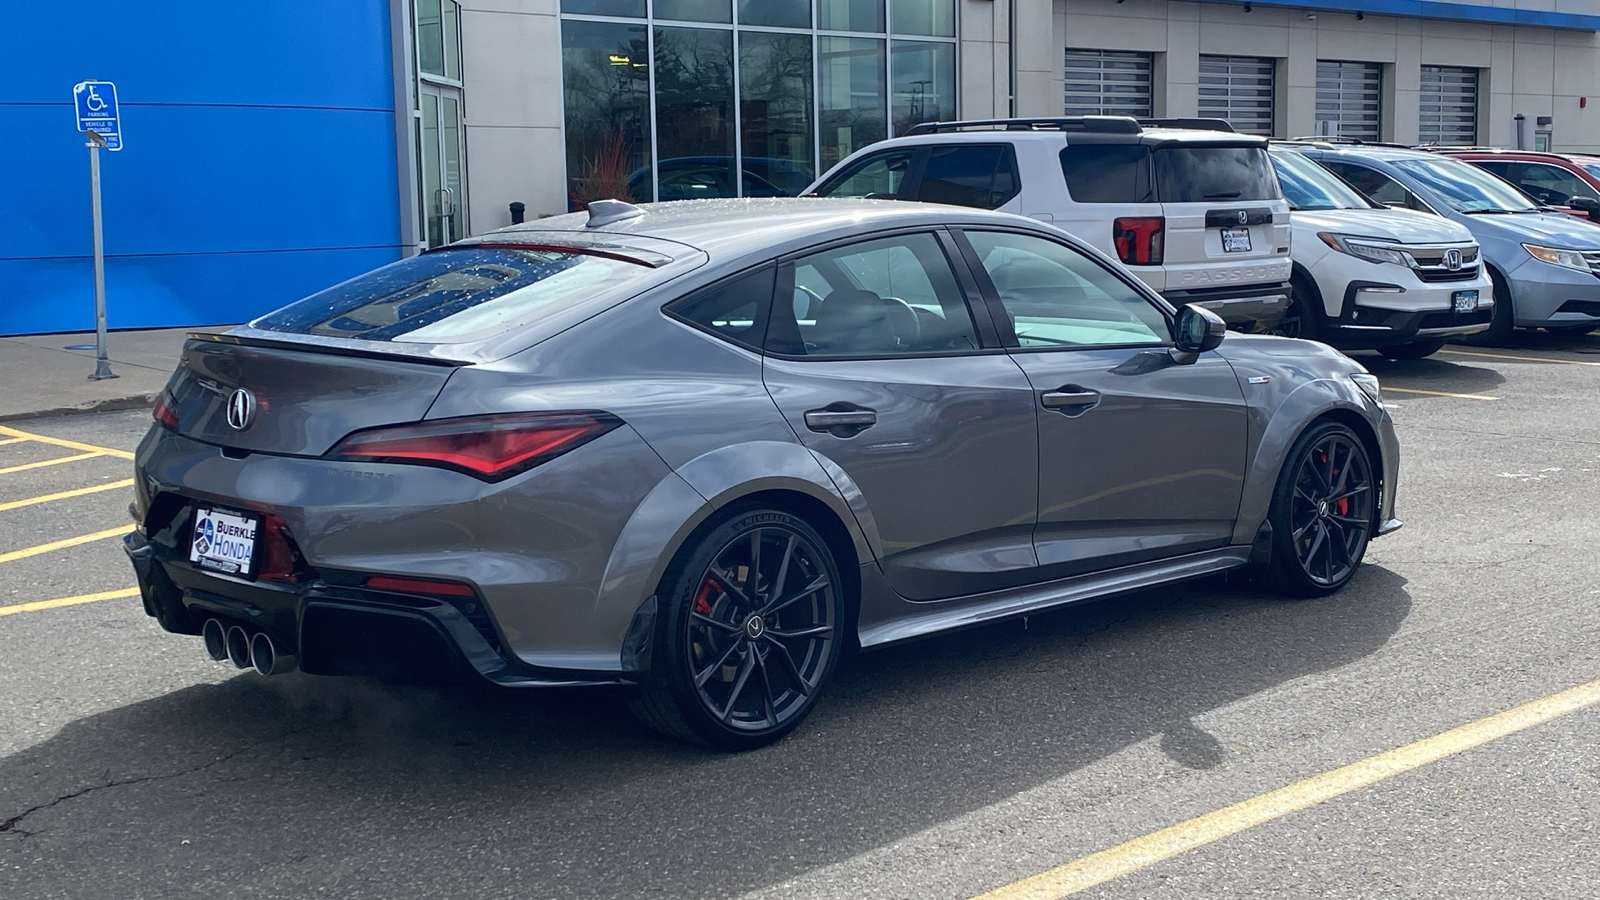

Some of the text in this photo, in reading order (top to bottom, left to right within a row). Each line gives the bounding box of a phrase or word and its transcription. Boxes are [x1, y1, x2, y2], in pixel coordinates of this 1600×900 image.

[1181, 266, 1288, 284] PASSPORT
[745, 514, 791, 525] MICHELIN
[216, 520, 256, 540] BUERKLE
[213, 534, 251, 560] HONDA
